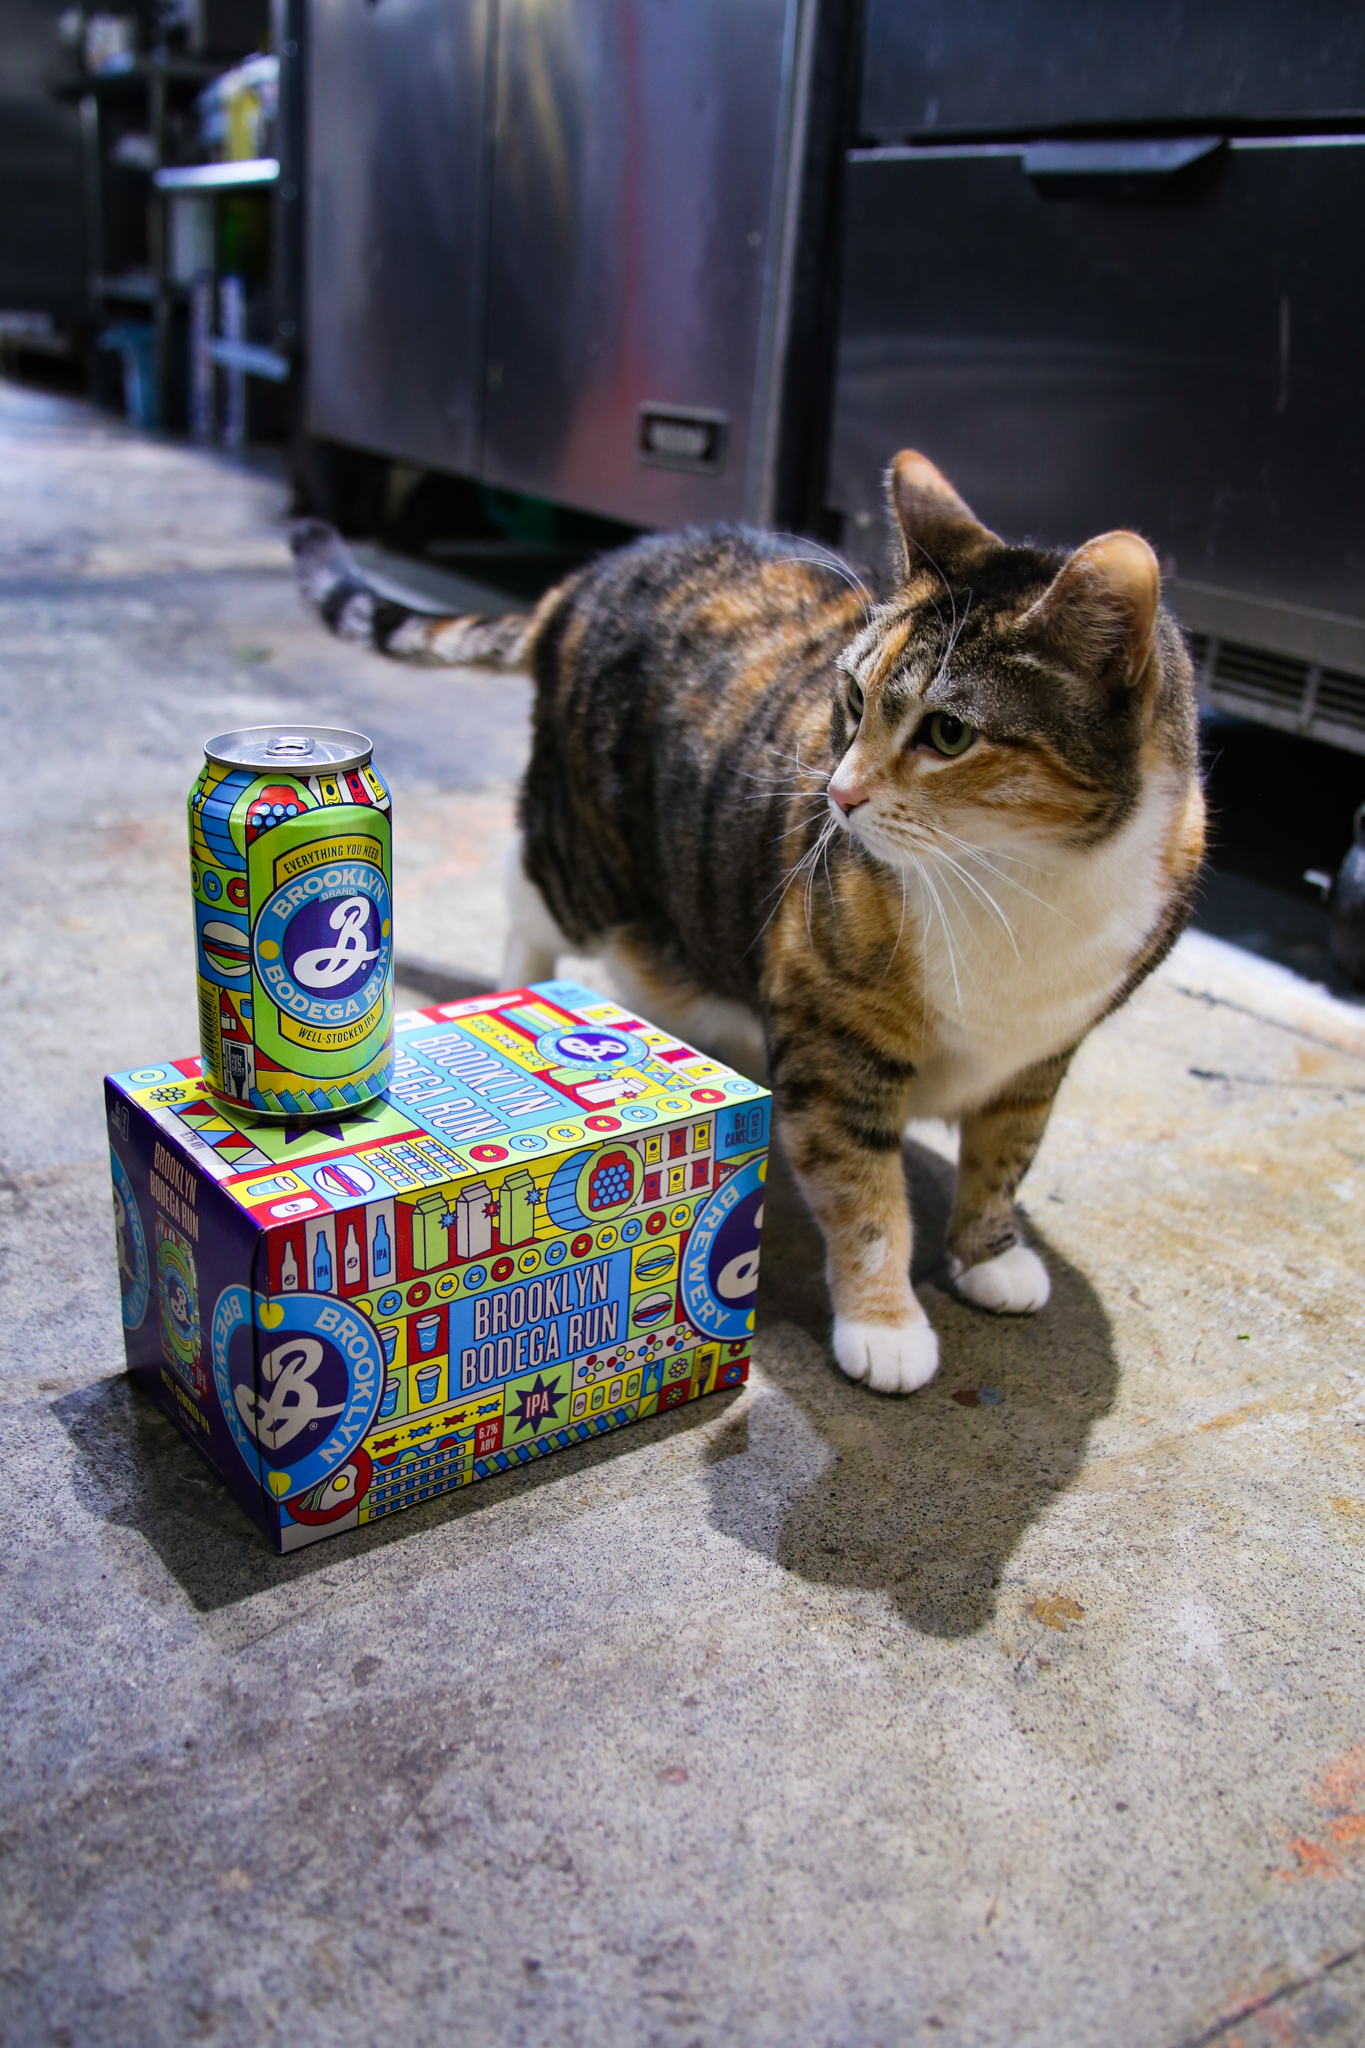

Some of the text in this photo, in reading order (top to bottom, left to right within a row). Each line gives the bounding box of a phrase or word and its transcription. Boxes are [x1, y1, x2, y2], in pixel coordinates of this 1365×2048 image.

[283, 844, 380, 874] EVERYTHING YOU NEED
[271, 868, 385, 921] BROOKLYN
[321, 887, 357, 900] BRAND
[265, 945, 389, 1021] BODEGA RUN
[298, 1013, 376, 1044] WELL-STOCKED IPA
[387, 1049, 511, 1142] DEGA RUN
[408, 1032, 563, 1118] BROOKLYN
[150, 1169, 199, 1241] BODEGA RUN
[154, 1141, 198, 1207] BROOKLYN
[317, 1265, 329, 1278] IPA
[376, 1248, 388, 1260] IPA
[689, 1185, 740, 1330] BREWERY
[474, 1259, 610, 1342] BROOKLYN
[214, 1294, 247, 1445] BREWERY
[460, 1301, 619, 1391] BODEGA RUN
[313, 1306, 375, 1465] BROOKLYN
[525, 1390, 549, 1418] IPA
[478, 1422, 499, 1440] 6.7%
[479, 1437, 496, 1453] ABV
